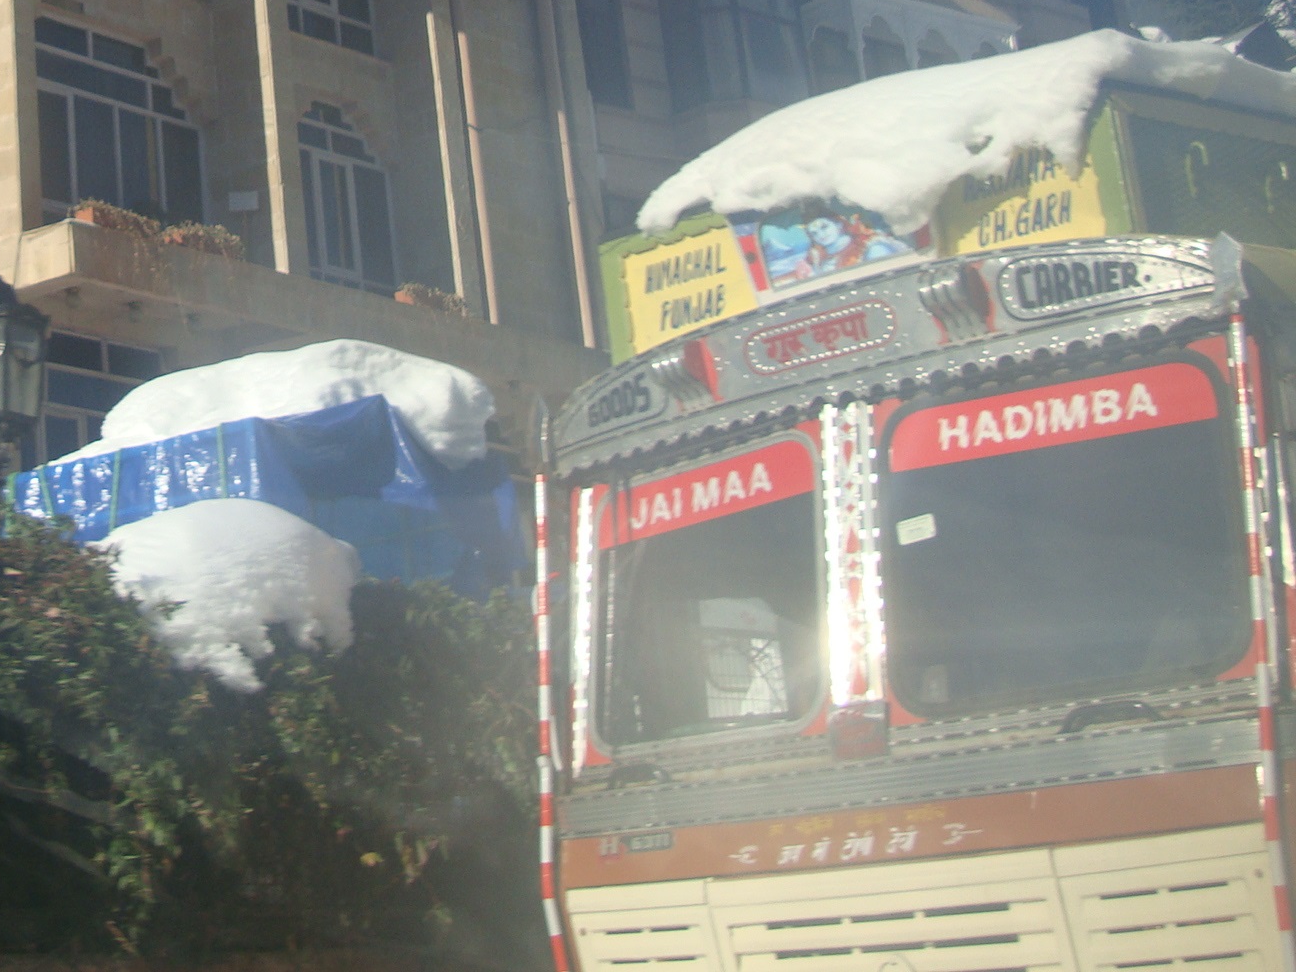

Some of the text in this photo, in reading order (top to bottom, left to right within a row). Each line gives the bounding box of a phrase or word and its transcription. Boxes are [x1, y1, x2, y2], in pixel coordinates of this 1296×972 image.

[977, 190, 1071, 247] CH.GARH
[1015, 261, 1142, 309] CARRIER
[588, 372, 651, 428] GOODS
[937, 382, 1159, 452] HADIMBA
[630, 462, 774, 530] JAI MAA
